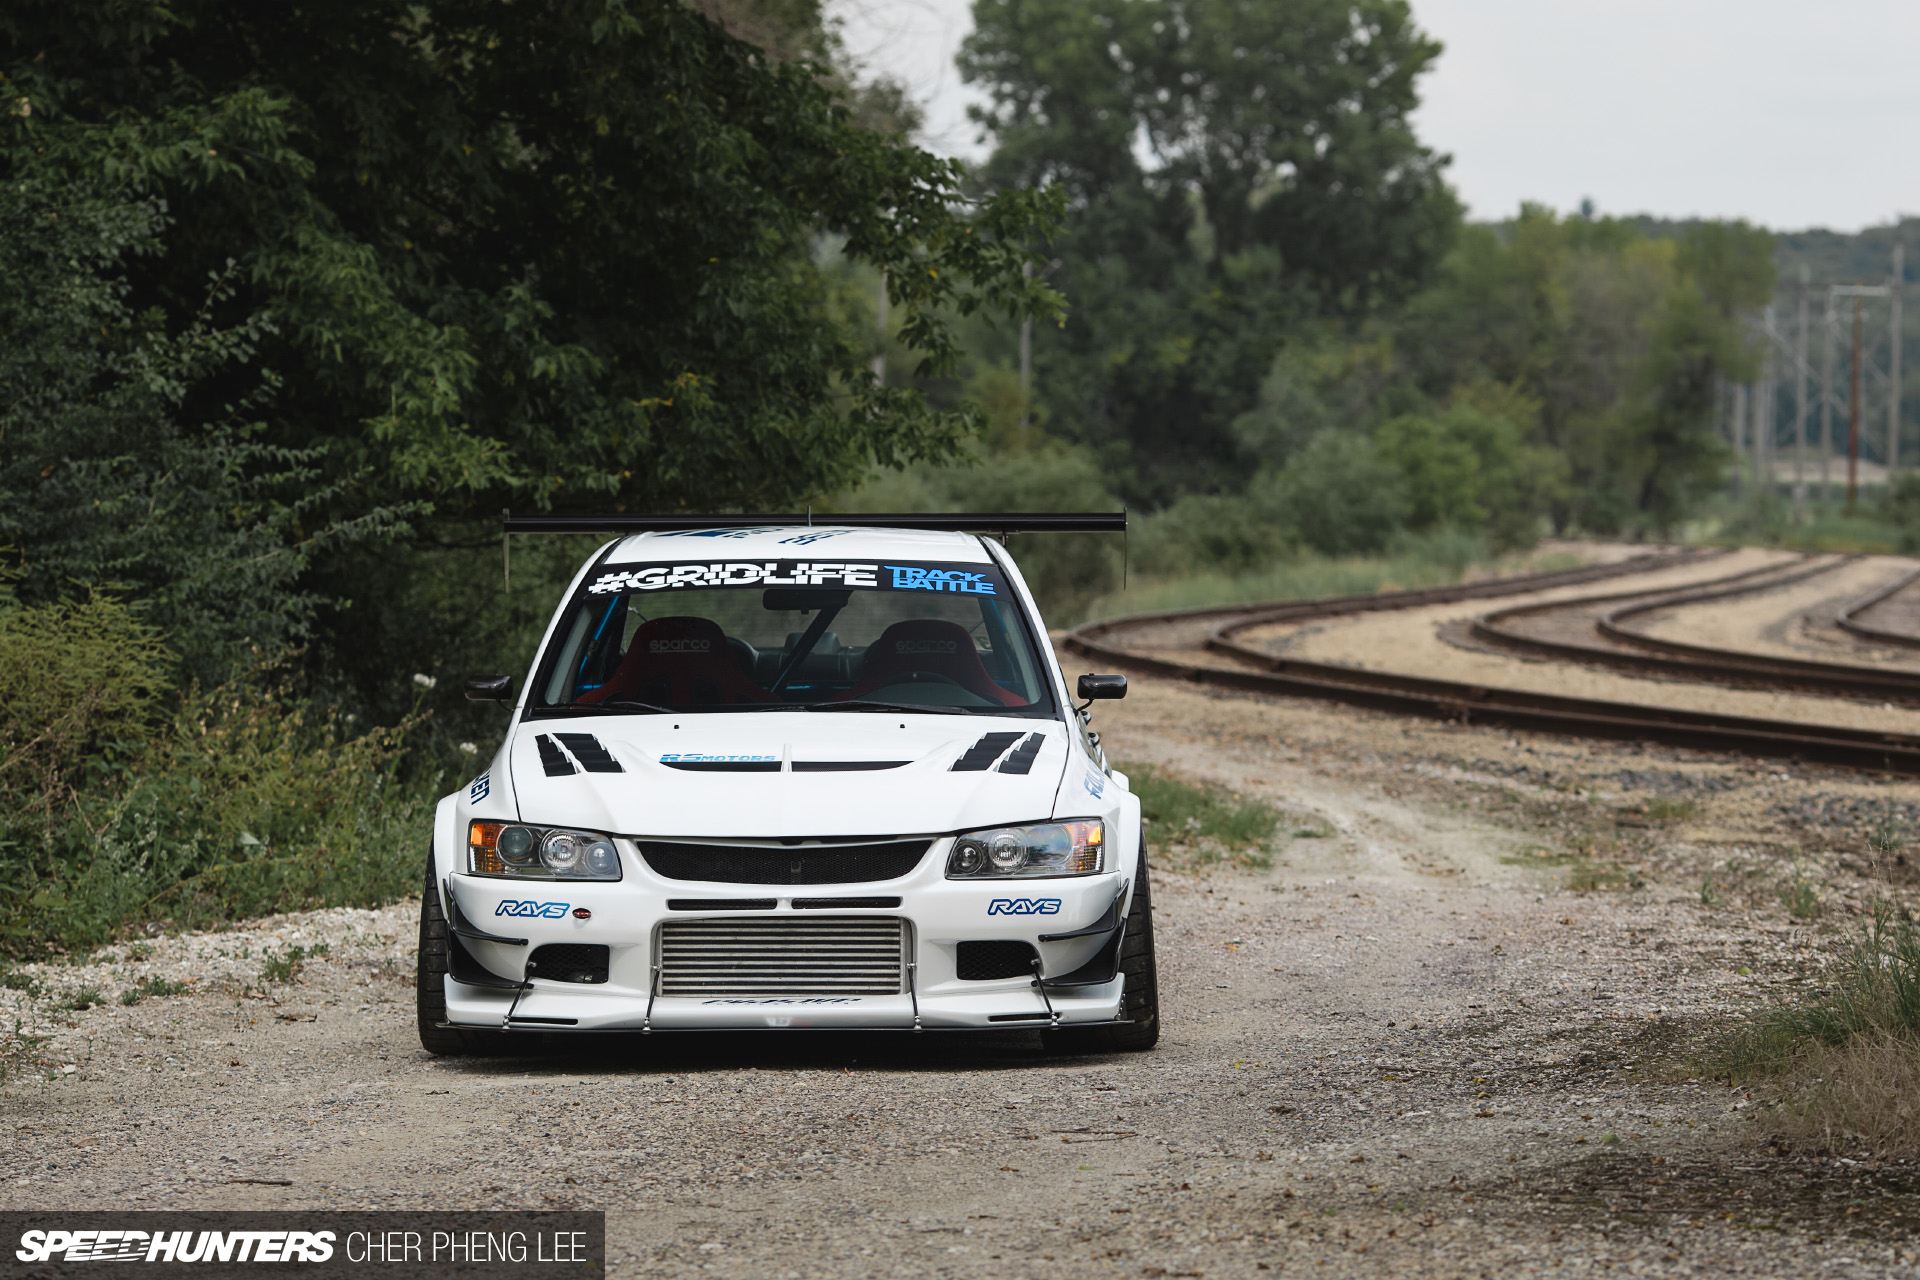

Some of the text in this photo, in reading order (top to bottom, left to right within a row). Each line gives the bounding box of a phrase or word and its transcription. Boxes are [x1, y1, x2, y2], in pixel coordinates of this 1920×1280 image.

[588, 562, 878, 594] #GRIDLIFE
[883, 565, 986, 582] TRACK
[893, 577, 997, 595] BATTLE
[650, 640, 710, 654] sparco
[896, 640, 956, 654] sparco
[495, 900, 570, 918] RAYS
[988, 898, 1062, 915] RAYS
